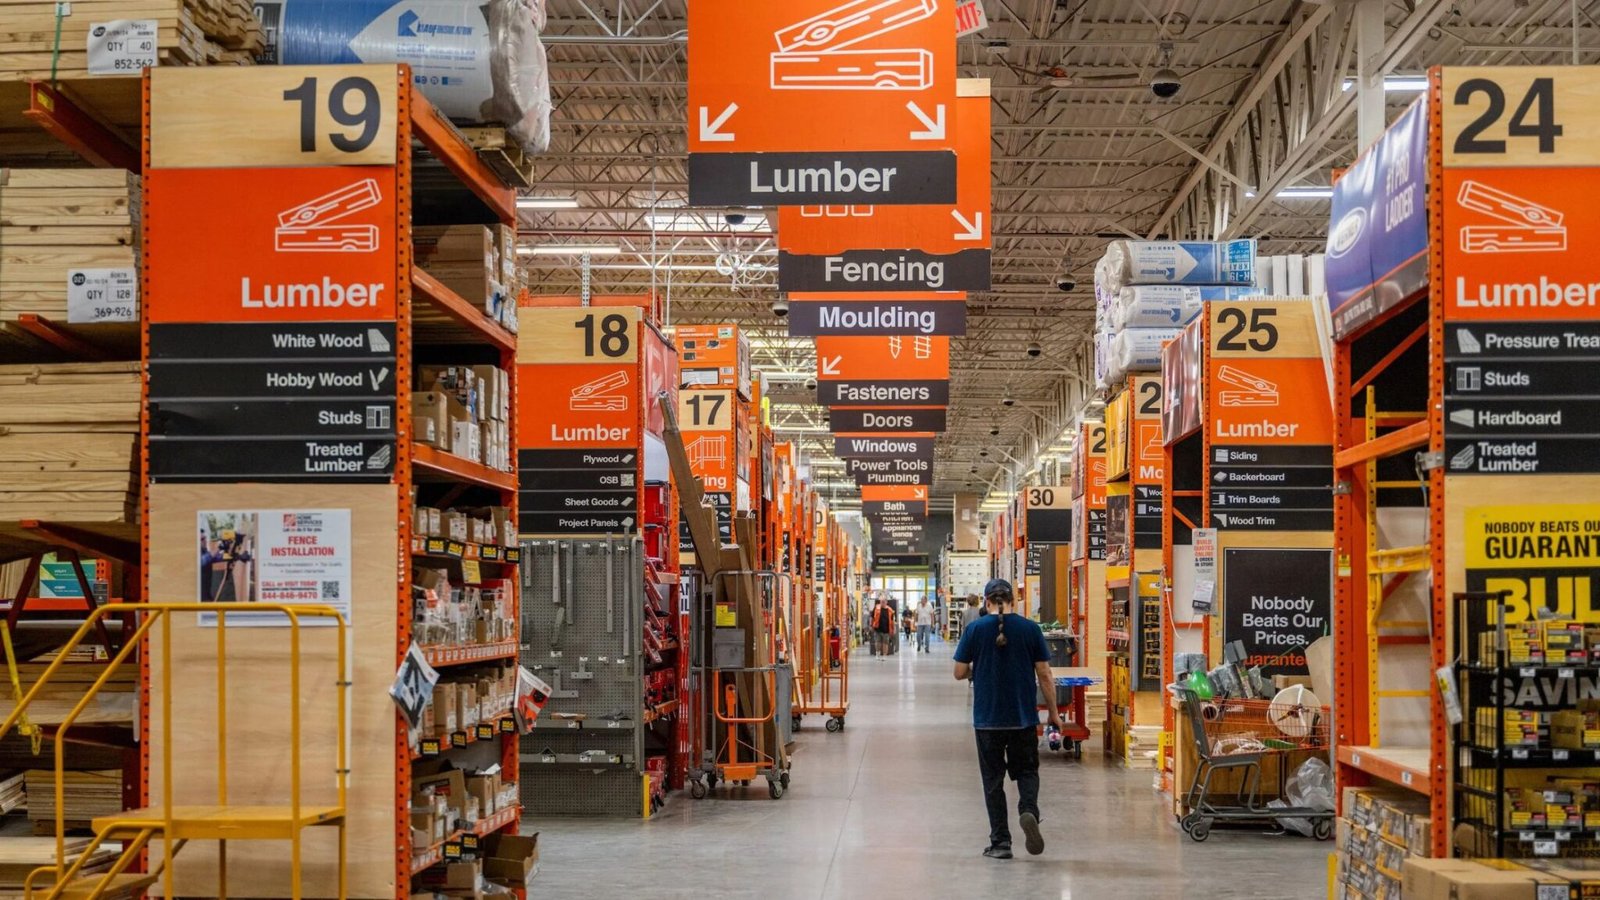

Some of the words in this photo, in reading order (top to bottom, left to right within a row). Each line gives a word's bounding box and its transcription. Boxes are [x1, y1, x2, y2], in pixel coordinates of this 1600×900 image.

[107, 42, 123, 52] QTY
[140, 42, 152, 51] 40
[282, 76, 382, 153] 19
[1453, 77, 1563, 154] 24
[750, 161, 897, 193] Lumber
[1385, 185, 1414, 232] LADDER
[825, 256, 945, 287] Fencing
[87, 290, 103, 300] QTY
[116, 290, 131, 299] 128
[241, 276, 384, 308] Lumber
[1456, 276, 1600, 308] Lumber
[95, 307, 132, 318] 369-926
[819, 306, 936, 333] Moulding
[574, 314, 630, 357] 18
[1216, 307, 1279, 352] 25
[272, 334, 316, 348] White
[319, 333, 363, 348] Wood
[1485, 333, 1560, 349] Pressure
[1563, 332, 1600, 348] Trea
[266, 373, 316, 389] Hobby
[319, 372, 363, 387] Wood
[1484, 371, 1530, 386] Studs
[837, 384, 930, 400] Fasteners
[1140, 381, 1162, 414] 2
[686, 395, 725, 425] 17
[1478, 410, 1562, 425] Hardboard
[318, 411, 363, 425] Studs
[863, 413, 913, 428] Doors
[551, 423, 631, 441] Lumber
[1216, 419, 1299, 437] Lumber
[851, 440, 917, 452] Windows
[1092, 427, 1106, 453] 2
[306, 442, 364, 456] Treated
[1478, 441, 1537, 456] Treated
[583, 455, 619, 464] Plywood
[1230, 452, 1258, 462] Siding
[1478, 457, 1539, 471] Lumber
[305, 458, 364, 472] Lumber
[851, 460, 891, 471] Power
[893, 459, 928, 471] Tools
[600, 476, 618, 484] OSB
[868, 473, 920, 484] Plumbing
[1229, 473, 1285, 481] Backerboard
[565, 498, 589, 506] Sheet
[591, 498, 619, 506] Goods
[1029, 488, 1054, 506] 30
[1228, 495, 1247, 504] Trim
[1249, 495, 1281, 504] Boards
[884, 502, 905, 511] Bath
[559, 519, 589, 528] Project
[591, 519, 619, 527] Panels
[1229, 516, 1254, 525] Wood
[1256, 516, 1275, 525] Trim
[1485, 521, 1535, 534] NOBODY
[1540, 520, 1580, 533] BEATS
[1584, 520, 1600, 532] OU
[288, 536, 318, 545] FENCE
[1485, 534, 1600, 559] GUARANT
[271, 547, 335, 556] INSTALLATION
[1251, 596, 1314, 613] Nobody
[1485, 577, 1600, 625] BUL
[1242, 613, 1289, 627] Beats
[1292, 613, 1323, 628] Our
[1255, 631, 1310, 645] Prices.
[1243, 653, 1308, 667] uarante
[1489, 677, 1600, 706] SAVIN
